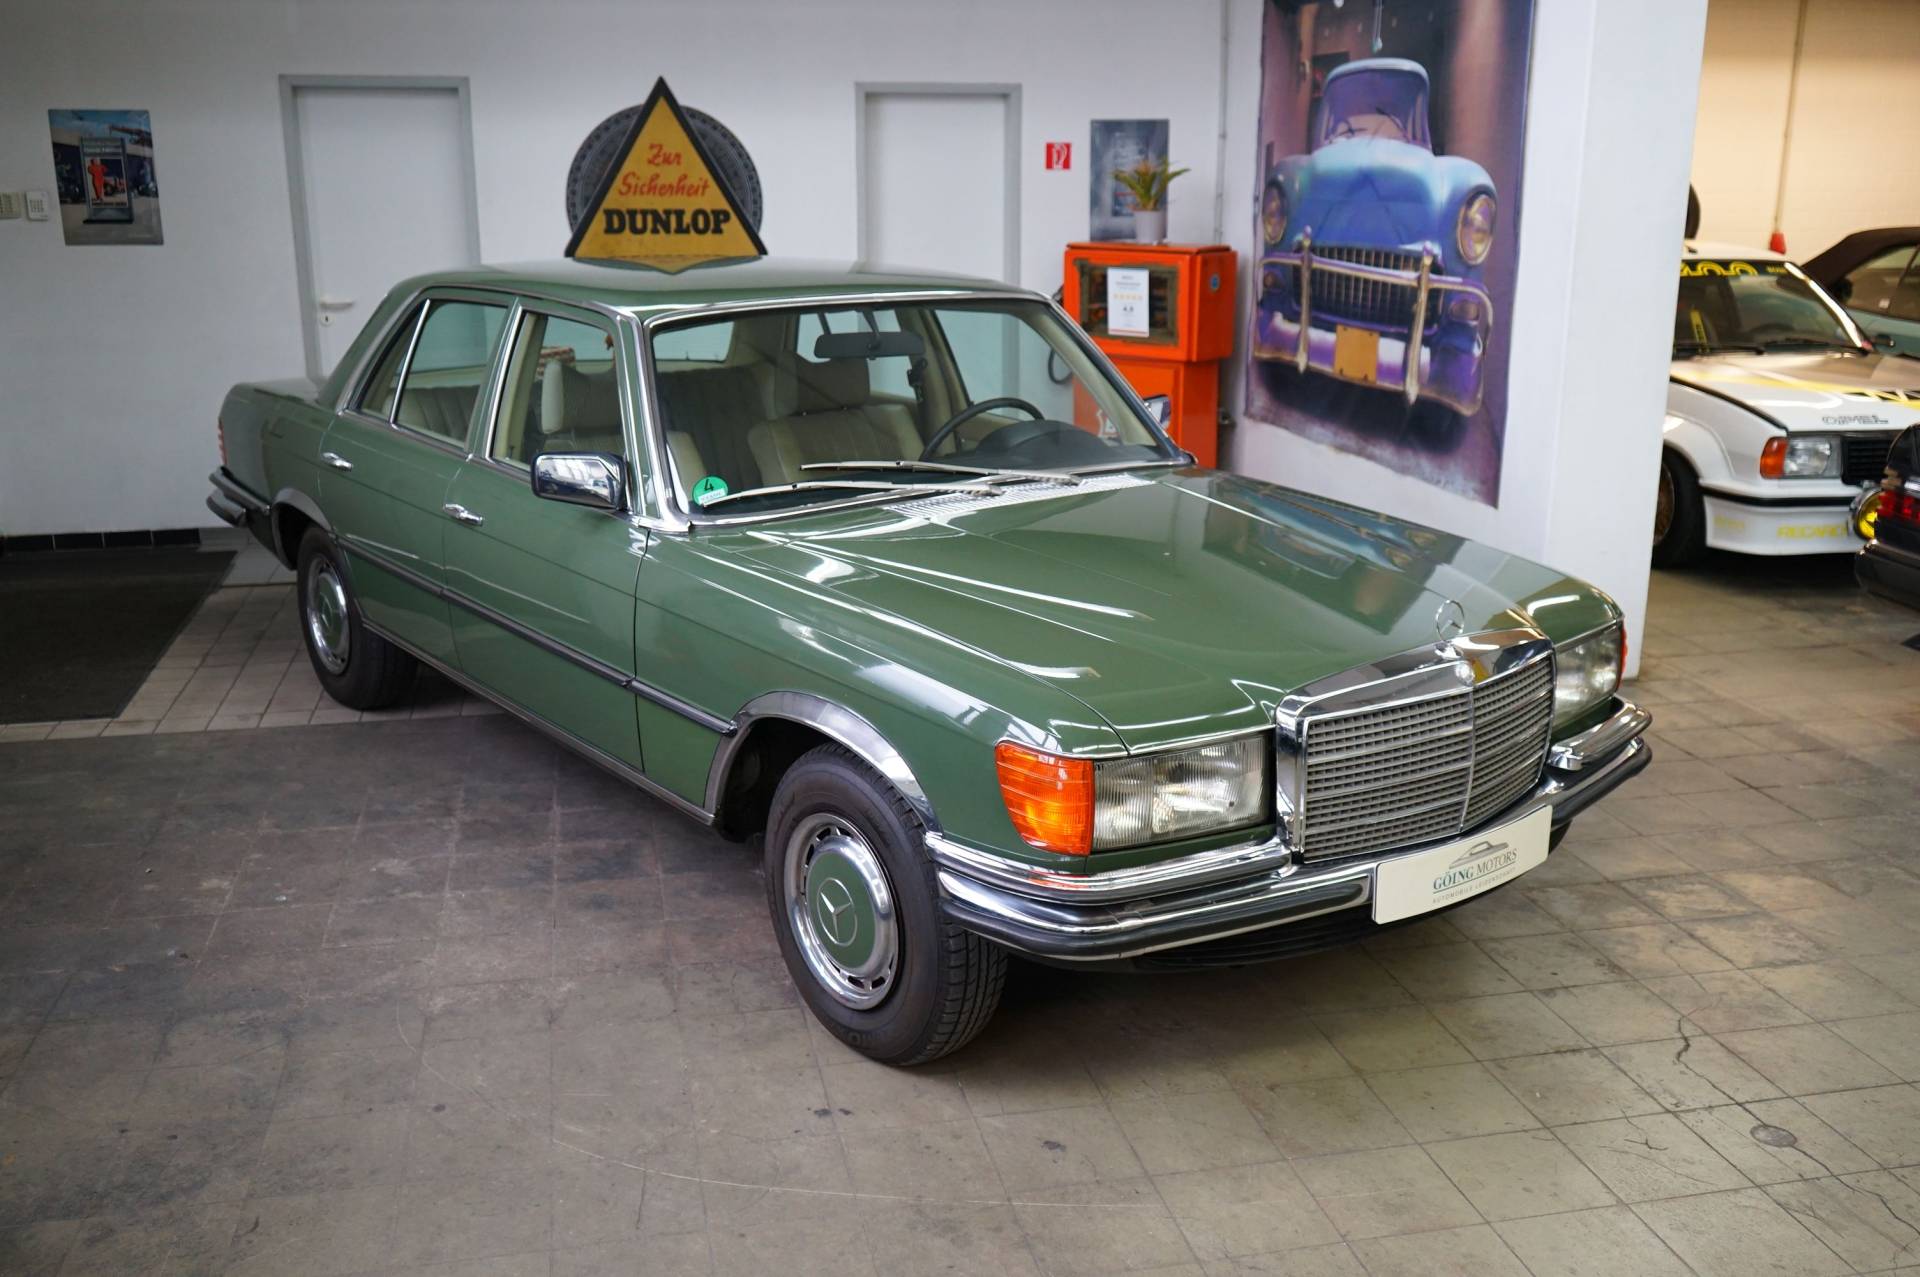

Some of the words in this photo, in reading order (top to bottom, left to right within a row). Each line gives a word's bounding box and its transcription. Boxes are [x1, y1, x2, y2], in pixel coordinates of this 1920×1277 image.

[647, 143, 683, 166] Zur
[618, 171, 710, 197] Sicherheit
[603, 209, 731, 234] DUNLOP
[704, 478, 714, 491] 4
[1433, 867, 1474, 890] GÖING
[1476, 849, 1518, 875] MOTORS
